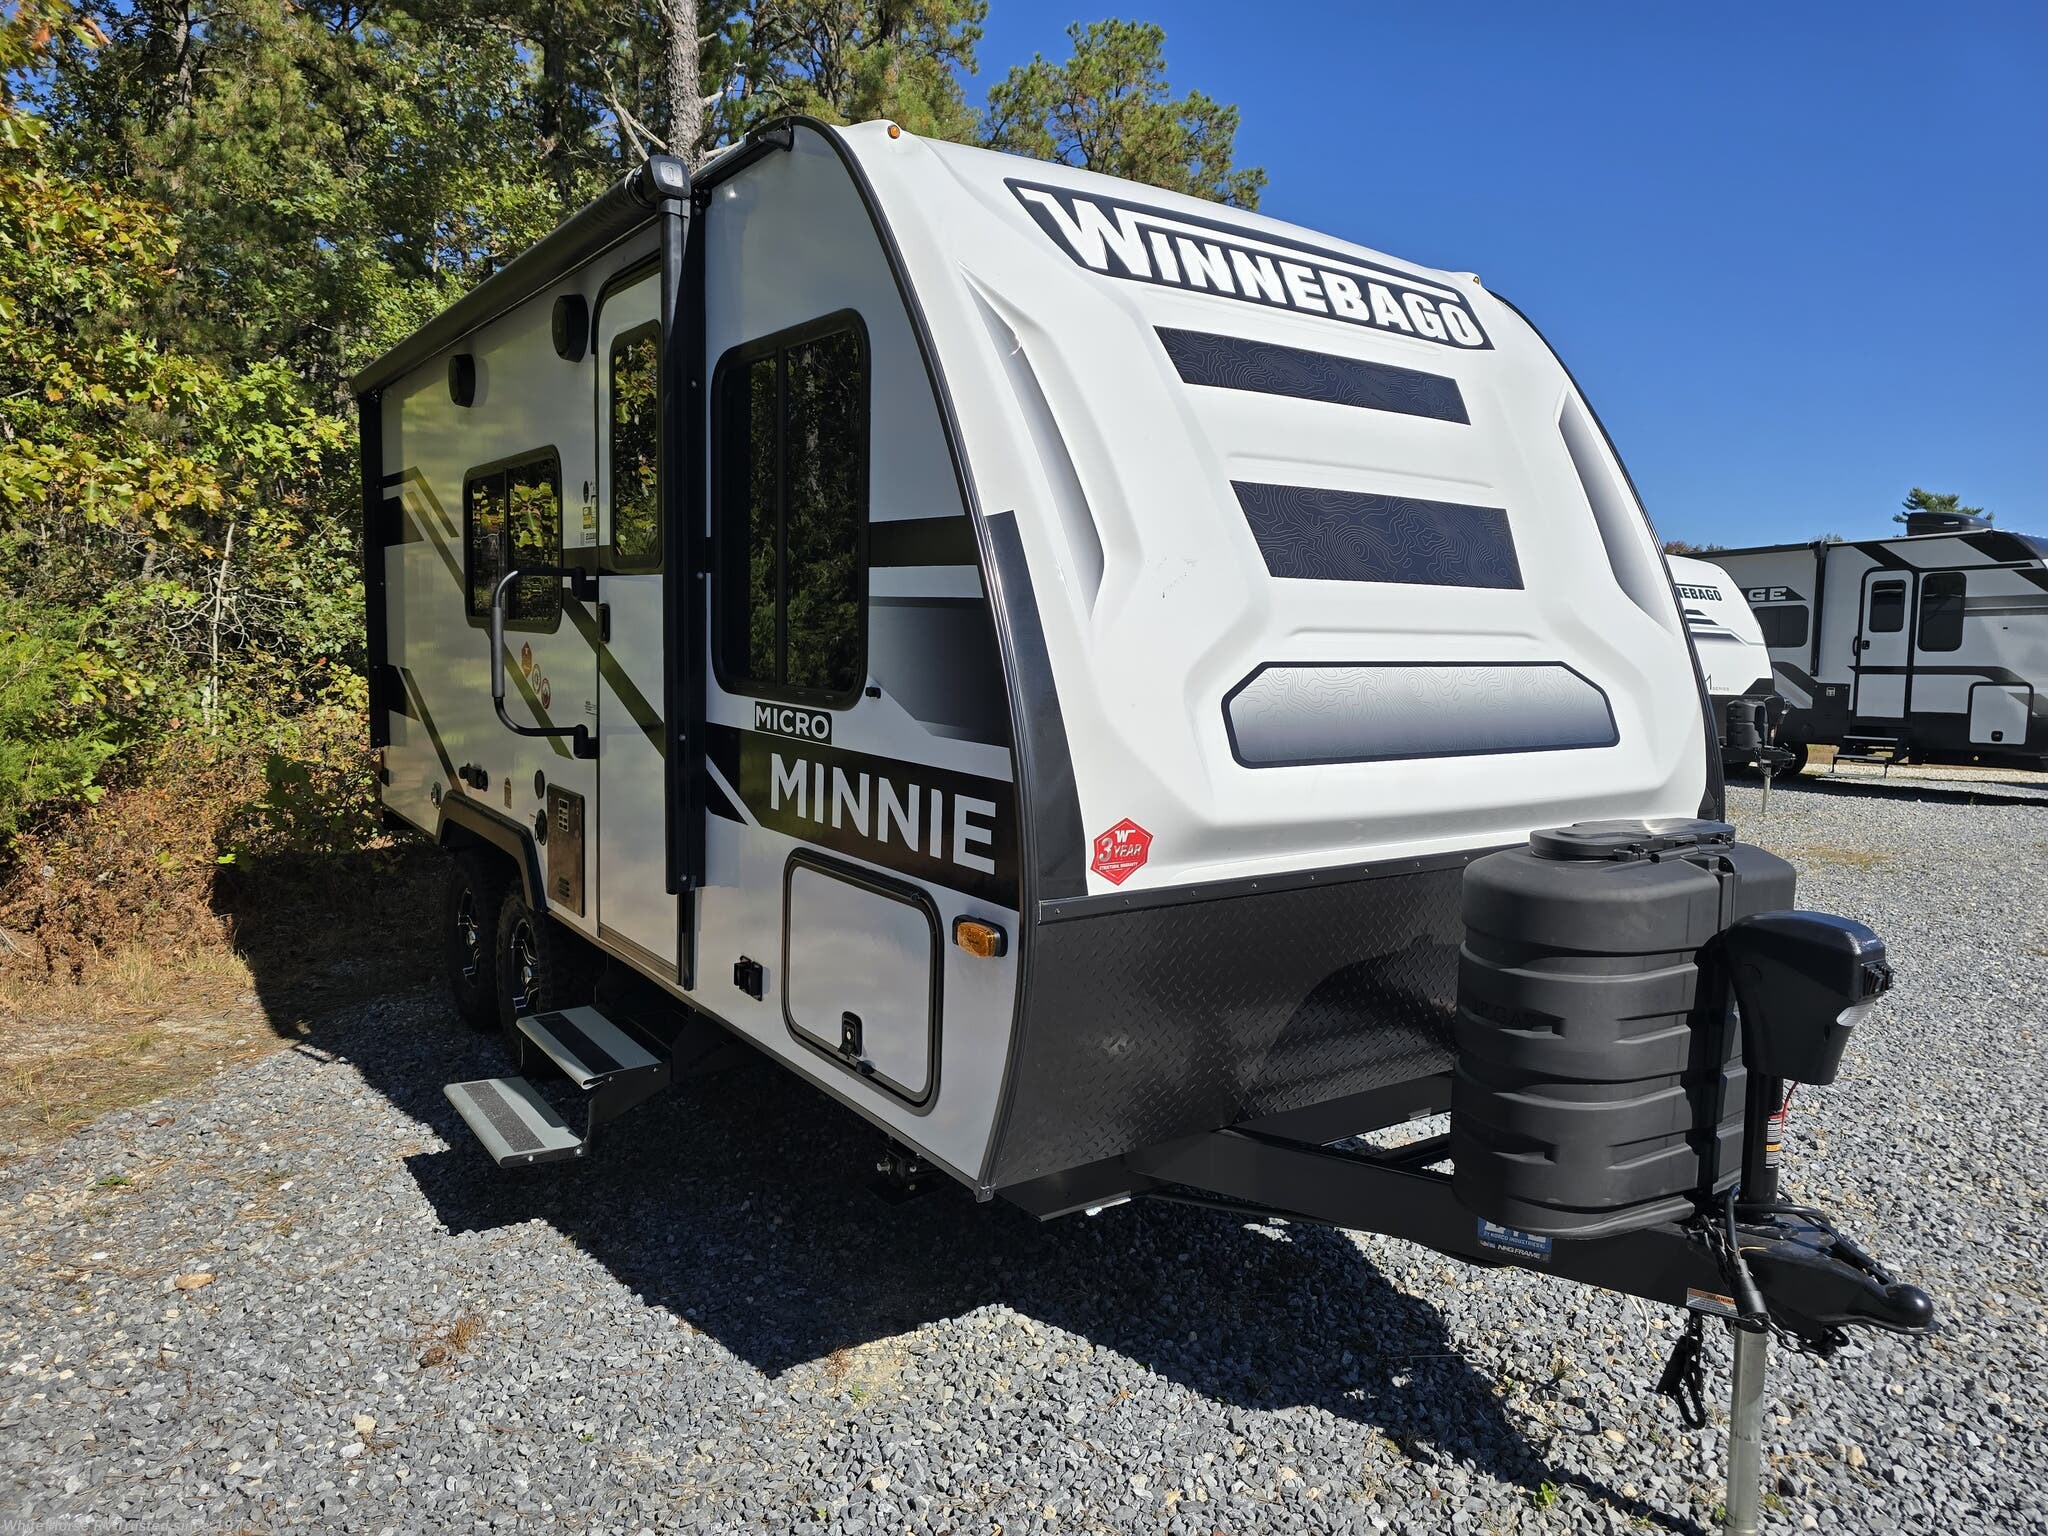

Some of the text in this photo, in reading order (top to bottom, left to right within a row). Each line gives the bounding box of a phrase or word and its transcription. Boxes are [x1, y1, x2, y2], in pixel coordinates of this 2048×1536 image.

[1016, 186, 1484, 347] WINNEBAGO
[755, 705, 831, 740] MICRO
[770, 752, 997, 875] MINNIE
[1099, 837, 1142, 862] 3 YEAR
